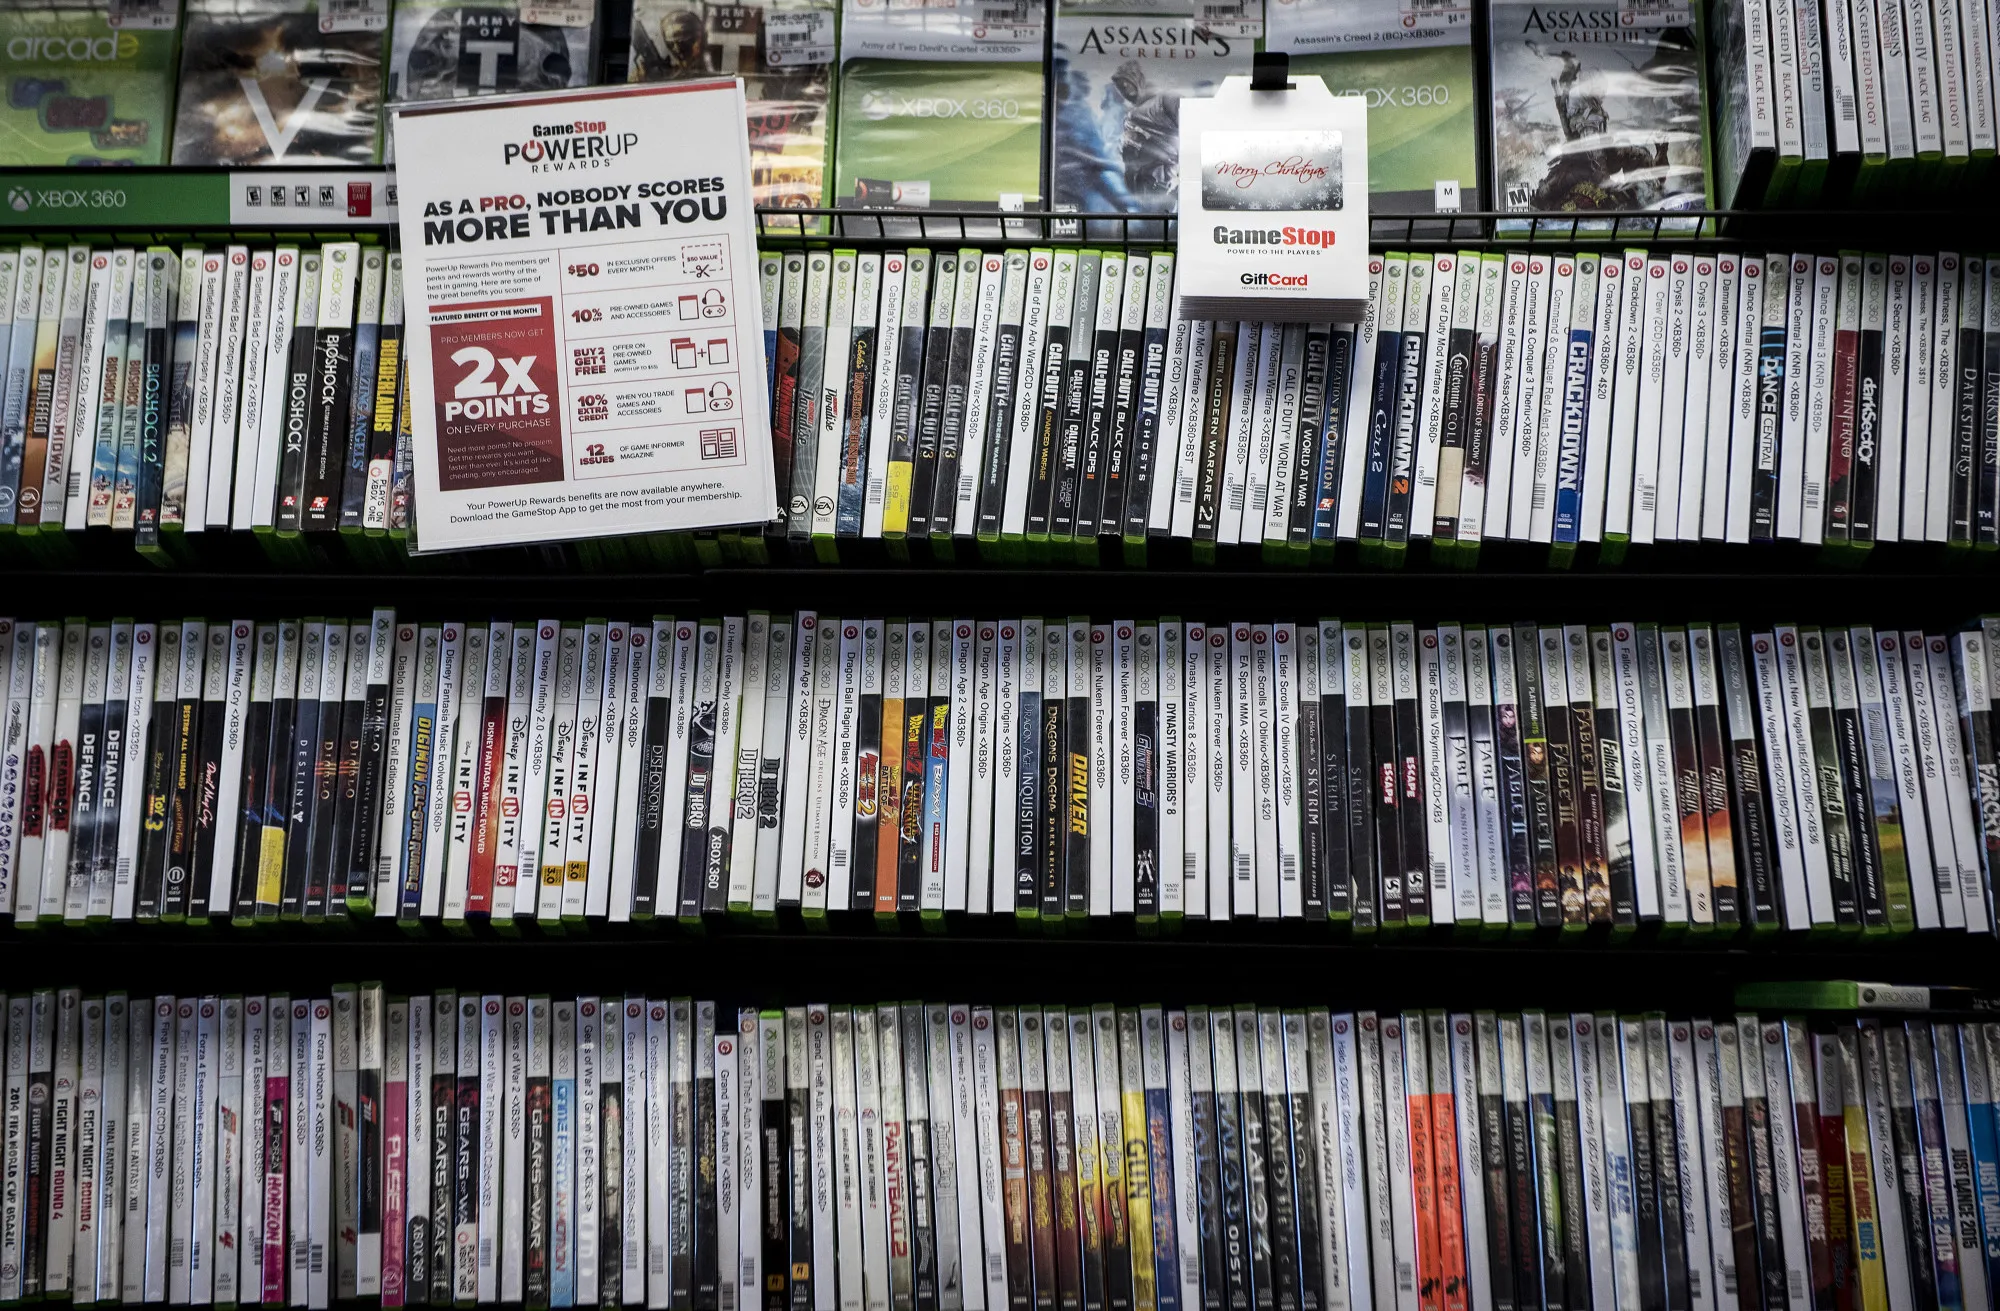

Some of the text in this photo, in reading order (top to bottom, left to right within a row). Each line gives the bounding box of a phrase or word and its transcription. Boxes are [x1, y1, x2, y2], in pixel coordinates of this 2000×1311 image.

[466, 15, 515, 27] ARMY
[479, 28, 501, 37] OF
[1293, 33, 1342, 46] Assassin's
[1343, 33, 1369, 44] Creed
[1372, 32, 1379, 42] 2
[1553, 30, 1640, 44] CREED III
[860, 41, 887, 53] Army
[889, 41, 898, 51] of
[898, 42, 917, 52] Two
[919, 43, 948, 53] Devil's
[951, 44, 977, 54] Cartel
[1119, 47, 1196, 60] CREED
[1751, 9, 1766, 121] CREED IV BLACK FLAG
[1809, 51, 1821, 93] CREED
[1862, 50, 1877, 127] EZIO TRILOGY
[900, 98, 1019, 119] XBOX 360
[1401, 85, 1449, 106] 360
[532, 120, 607, 137] GameStop
[504, 133, 638, 165] POWERUP
[532, 158, 611, 174] REWARDS
[1214, 155, 1330, 189] Merry Christmas
[36, 190, 126, 208] XBOX 360
[424, 176, 725, 218] AS A PRO, NOBODY SCORES
[423, 195, 728, 246] MORE THAN YOU
[1212, 225, 1336, 249] GameStop
[568, 263, 599, 278] $50
[607, 265, 654, 275] EVERY MONTH
[615, 257, 650, 267] EXCLUSIVE
[651, 255, 677, 264] OFFERS
[1240, 272, 1308, 287] GiftCard
[431, 314, 462, 322] FEATURED
[463, 311, 488, 319] BENEFIT
[513, 307, 538, 315] MONTH
[571, 308, 602, 323] 10%
[1629, 277, 1641, 324] Crackdown
[441, 328, 545, 344] PRO MEMBERS NOW GET
[573, 347, 605, 357] BUY 2
[879, 286, 898, 420] Cabela's African Adv <XB360>
[1625, 336, 1636, 375] <XB360>
[321, 335, 339, 404] BIOSHOCK
[450, 346, 541, 399] 2x
[574, 355, 606, 366] GET 1
[574, 365, 607, 376] FREE
[374, 340, 399, 432] BORDERLANDS
[577, 394, 609, 407] 10%
[144, 364, 160, 462] BIOSHOCK 2
[288, 373, 307, 452] BIOSHOCK
[445, 393, 550, 422] POINTS
[446, 418, 551, 435] ON EVERY PURCHASE
[577, 406, 609, 415] EXTRA
[578, 413, 609, 422] CREDIT
[824, 388, 837, 431] Paradise
[1393, 336, 1421, 494] CRACKDOWN 2
[1559, 342, 1588, 490] CRACKDOWN
[1858, 378, 1877, 465] darkSector
[579, 455, 615, 465] ISSUES
[585, 443, 605, 456] 12
[1111, 412, 1124, 472] BLACK OPS
[1139, 419, 1151, 481] GHOSTS
[1199, 378, 1222, 520] MODERN WARFARE 2
[1297, 429, 1312, 506] WORLD AT WAR
[450, 511, 494, 523] Download
[495, 511, 510, 519] the
[511, 507, 557, 518] GameStop
[558, 504, 577, 515] App
[589, 502, 603, 512] get
[605, 501, 620, 510] the
[621, 500, 643, 508] most
[644, 497, 664, 506] from
[665, 497, 685, 506] your
[687, 490, 742, 502] membership.
[466, 502, 486, 511] Your
[488, 499, 528, 510] PowerUp
[529, 495, 566, 505] Rewards
[568, 492, 602, 502] benefits
[604, 491, 618, 499] are
[640, 485, 679, 495] available
[680, 481, 725, 493] anywhere.
[957, 642, 969, 674] Dragon
[957, 676, 967, 695] Age
[956, 706, 966, 748] <XB360>
[1166, 703, 1177, 747] DYNASTY
[1886, 656, 1915, 800] Farming Simulator 15 <XB360>
[414, 717, 431, 781] DIGIMON
[103, 730, 120, 808] DEFIANCE
[296, 740, 308, 807] DESTINY
[477, 722, 495, 853] DISNEY FANTASIA: MUSIC EVOLVED
[647, 746, 664, 829] DISHONORED
[1406, 757, 1415, 797] ESCAPE
[572, 764, 589, 843] INFINITY
[1021, 772, 1033, 855] INQUISITION
[1072, 753, 1087, 835] DRIVER
[1308, 769, 1319, 824] SKYRIM
[708, 834, 723, 889] XBOX 360
[83, 1110, 95, 1142] FIGHT
[82, 1146, 93, 1179] NIGHT
[1126, 1140, 1148, 1199] GUN
[81, 1182, 92, 1221] ROUND
[267, 1177, 281, 1241] HORIZON
[1952, 1148, 1978, 1249] JUST DANCE 2015
[1229, 1226, 1241, 1285] ODST
